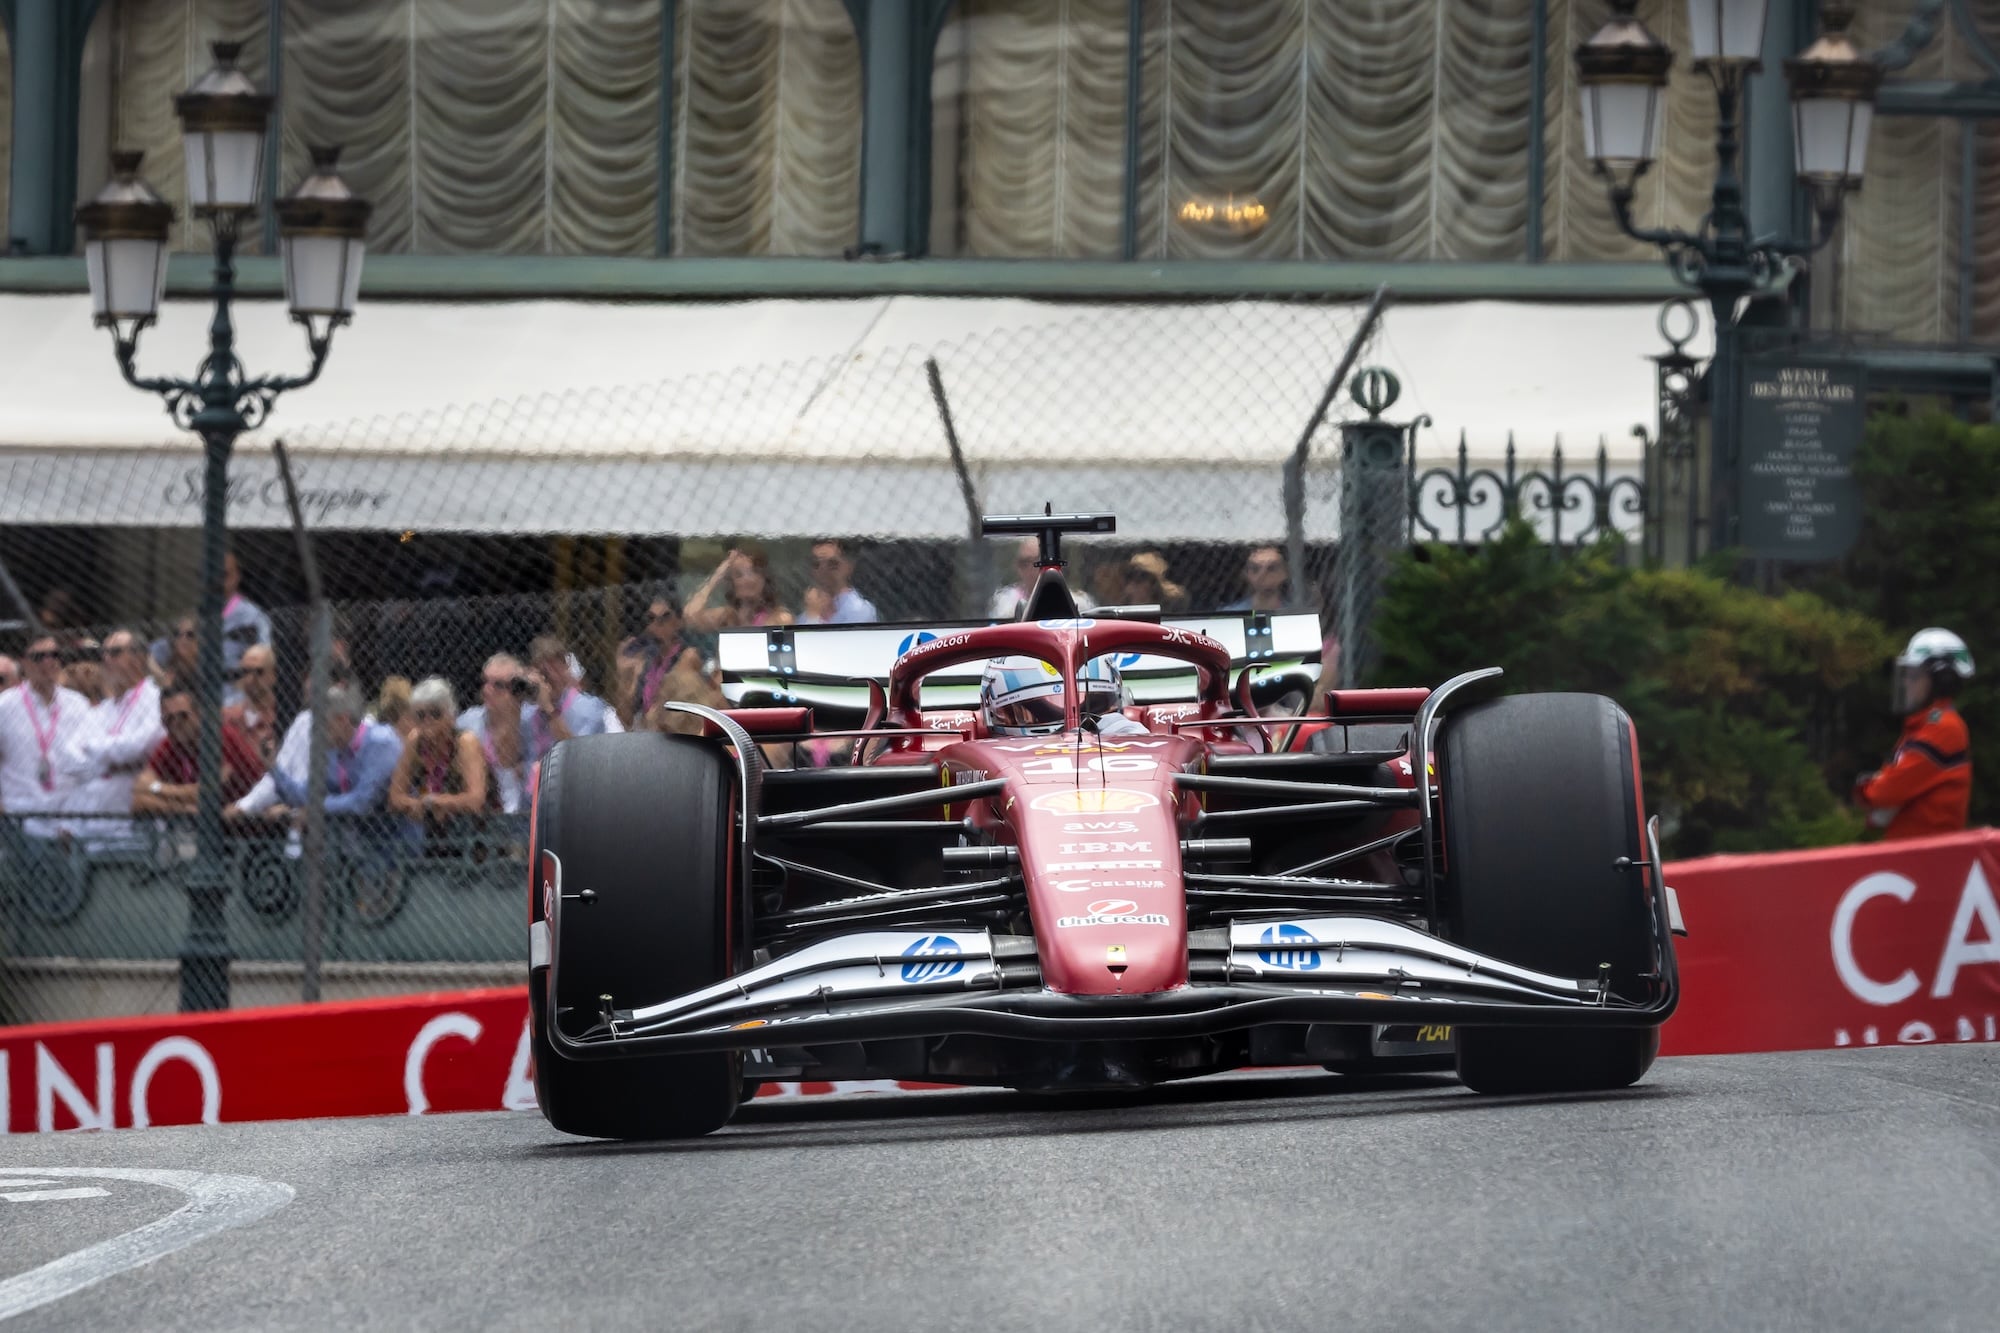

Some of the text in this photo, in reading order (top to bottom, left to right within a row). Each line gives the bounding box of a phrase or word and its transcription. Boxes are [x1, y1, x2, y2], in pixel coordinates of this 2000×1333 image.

[911, 634, 970, 656] TECHNOLOGY
[923, 711, 977, 730] Ray-Ban
[1147, 705, 1200, 724] Ray-Ban
[1022, 755, 1159, 775] 16
[1063, 821, 1138, 833] aws
[1058, 841, 1153, 855] IBM
[1058, 914, 1168, 928] UniCredit
[1416, 1024, 1452, 1042] PLAY
